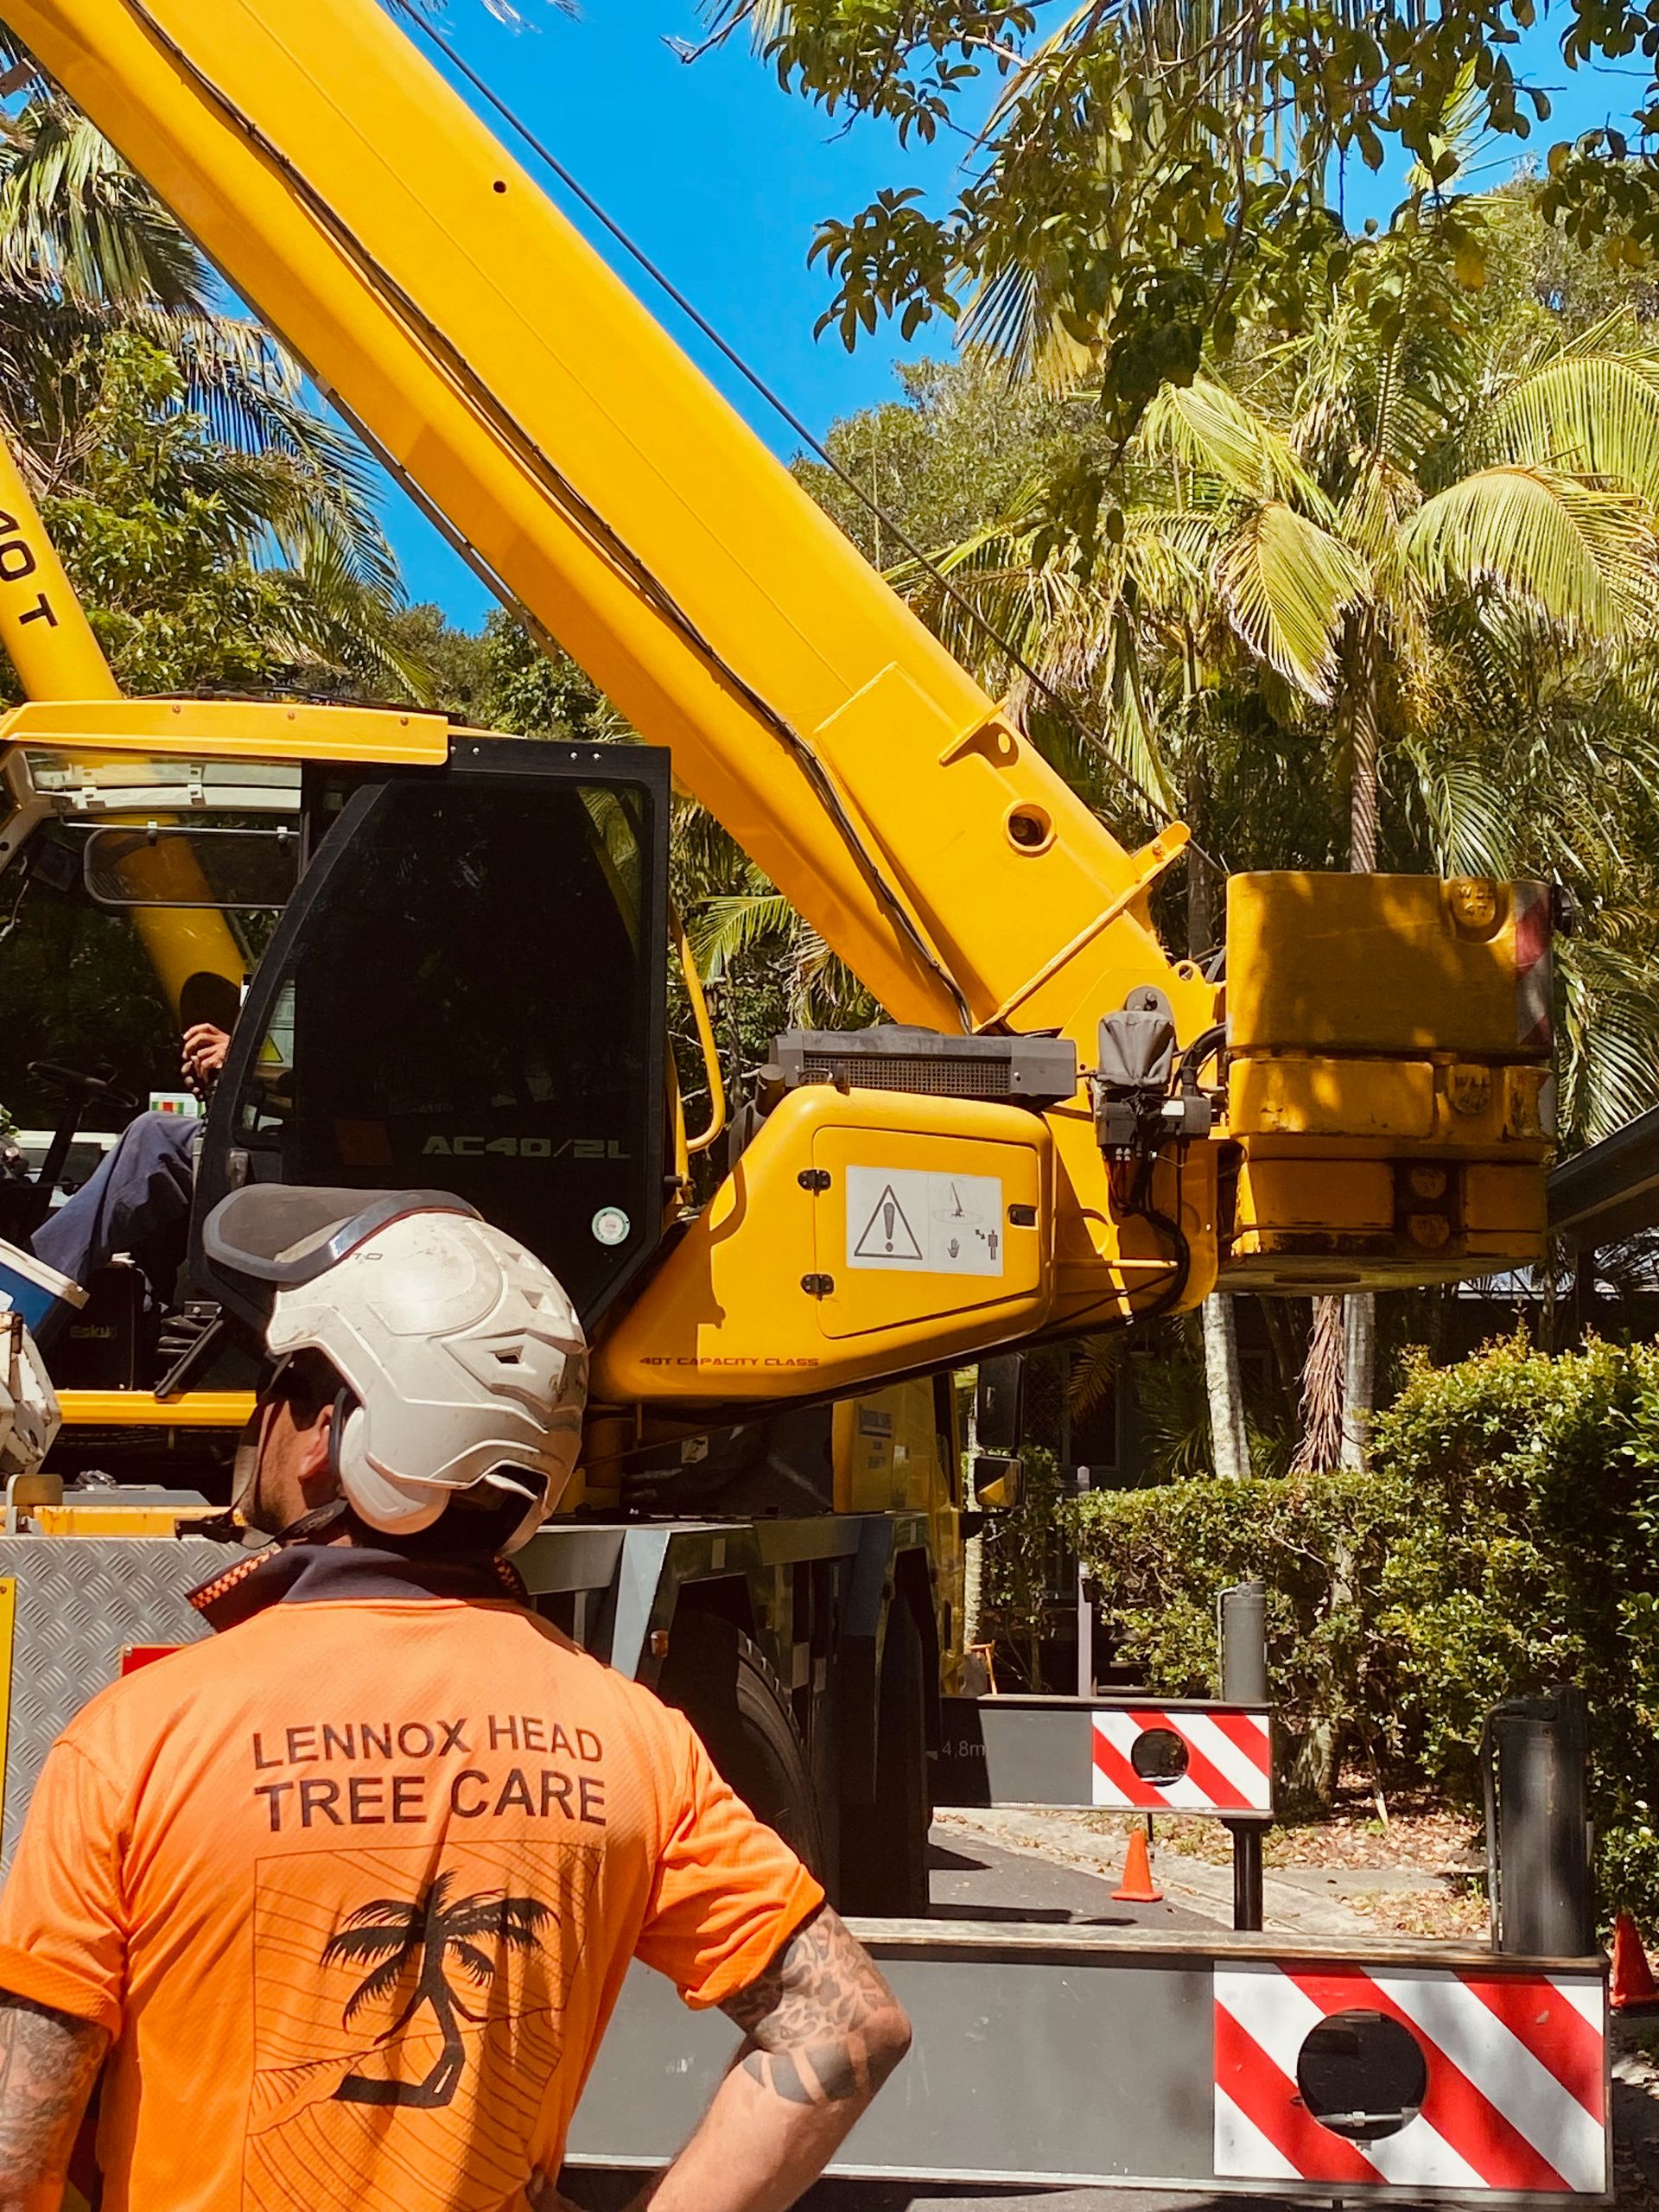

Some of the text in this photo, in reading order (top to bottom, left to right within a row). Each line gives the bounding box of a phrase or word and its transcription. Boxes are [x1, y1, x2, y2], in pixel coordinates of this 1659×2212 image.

[422, 1135, 632, 1160] AC40/2L
[639, 1357, 820, 1367] 40T CAPACITY CLASS
[252, 1713, 604, 1770] LENNOX HEAD
[253, 1767, 607, 1832] TREE CARE
